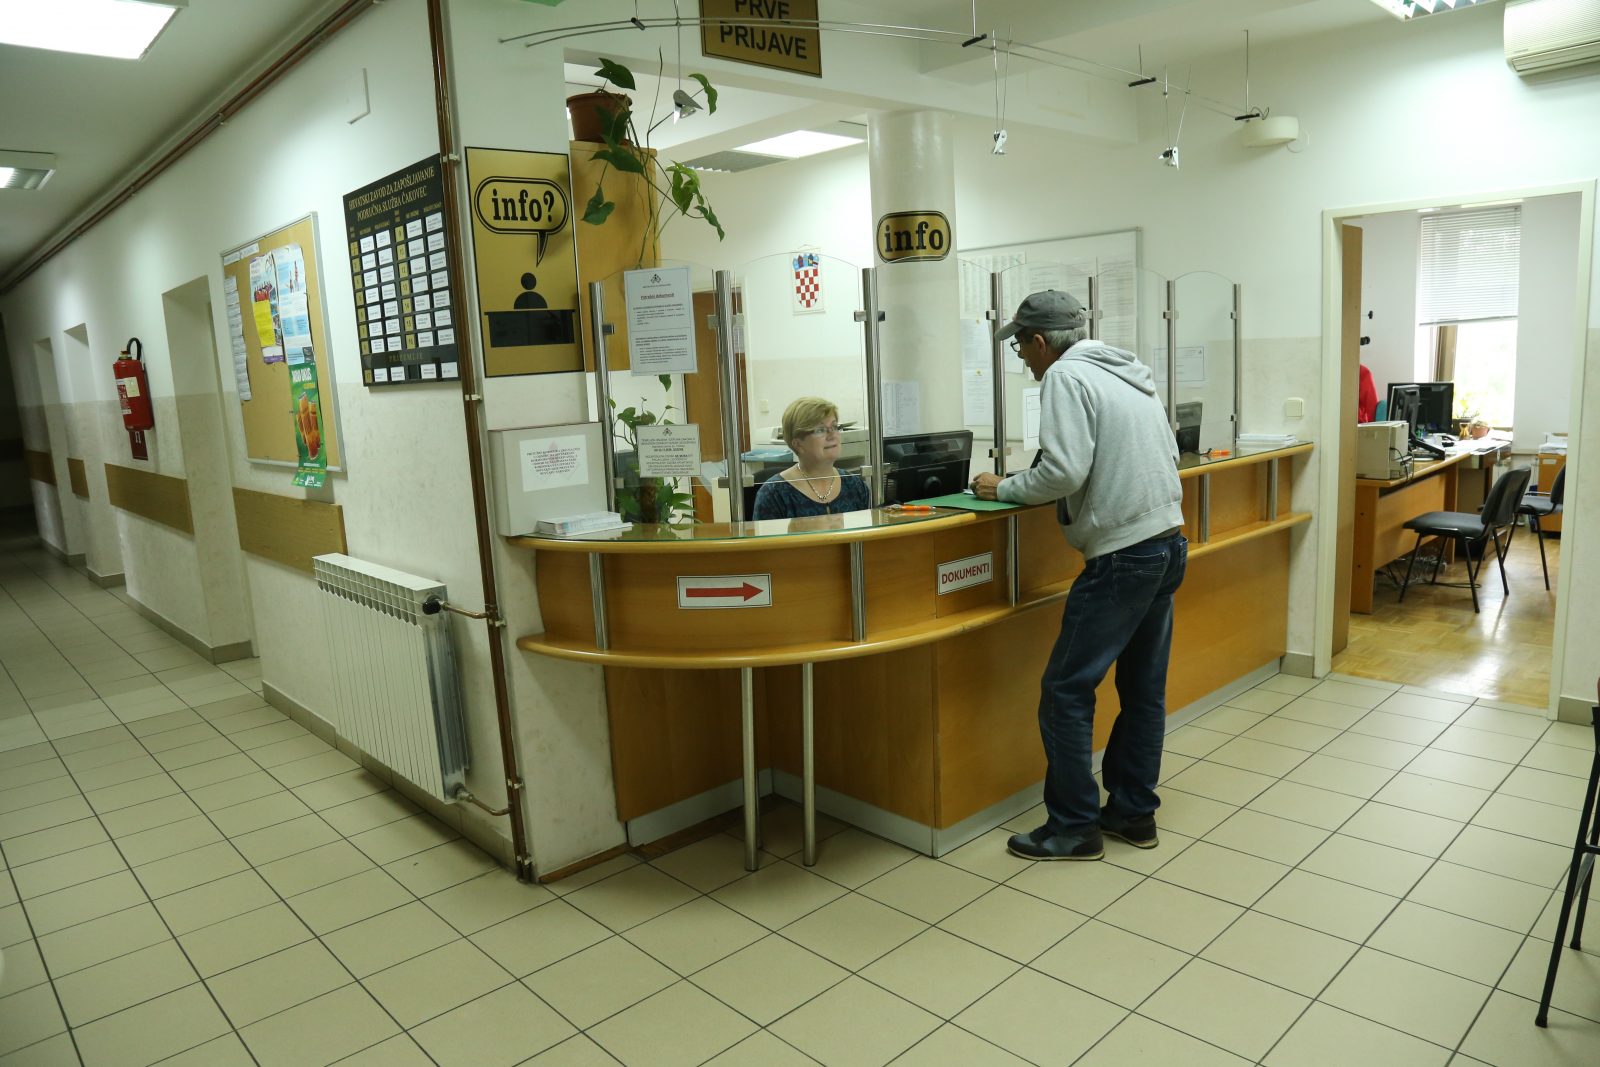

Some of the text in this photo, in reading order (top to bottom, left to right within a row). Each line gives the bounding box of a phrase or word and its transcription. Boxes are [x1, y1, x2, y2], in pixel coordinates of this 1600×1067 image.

[735, 0, 791, 24] PRVE
[720, 21, 807, 59] PRIJAVE
[349, 166, 434, 210] HRVATSKI ZAVOD ZA ZAPOŠLJAVANJE
[382, 196, 402, 212] SLUŽBA
[401, 185, 427, 206] ČAKOVEC
[492, 188, 554, 222] info?
[884, 221, 943, 252] info
[941, 562, 989, 585] DOKUMENTI
